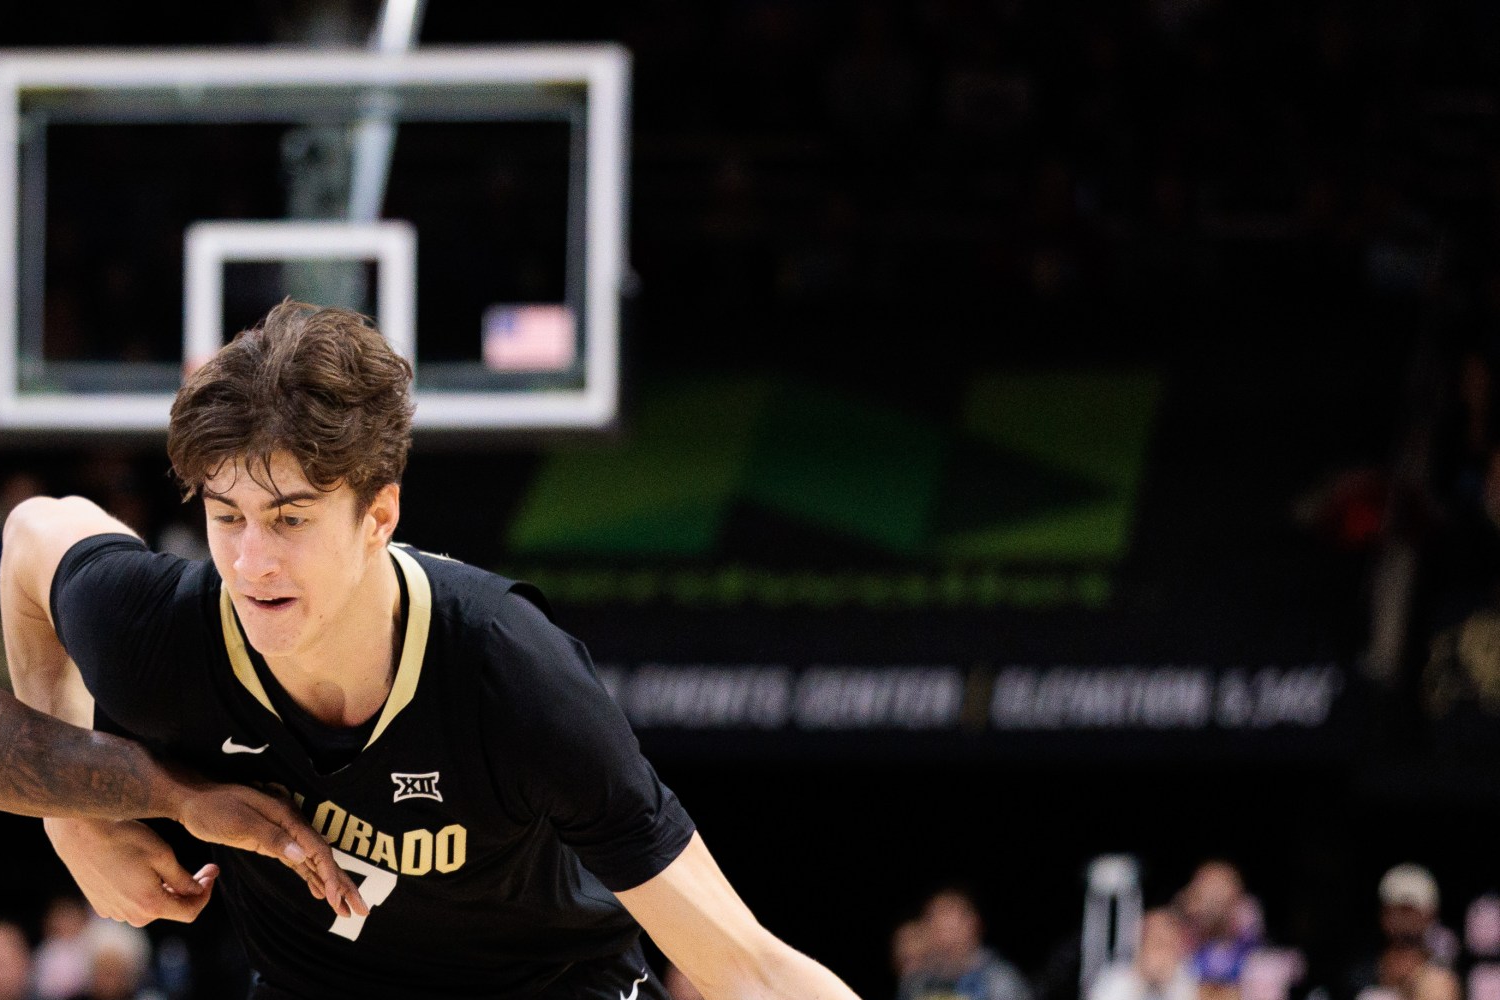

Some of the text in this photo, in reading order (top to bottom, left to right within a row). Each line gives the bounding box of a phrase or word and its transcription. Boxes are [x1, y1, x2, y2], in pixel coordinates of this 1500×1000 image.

[394, 774, 440, 800] XII
[296, 793, 467, 876] ORADO
[328, 848, 398, 941] 7
